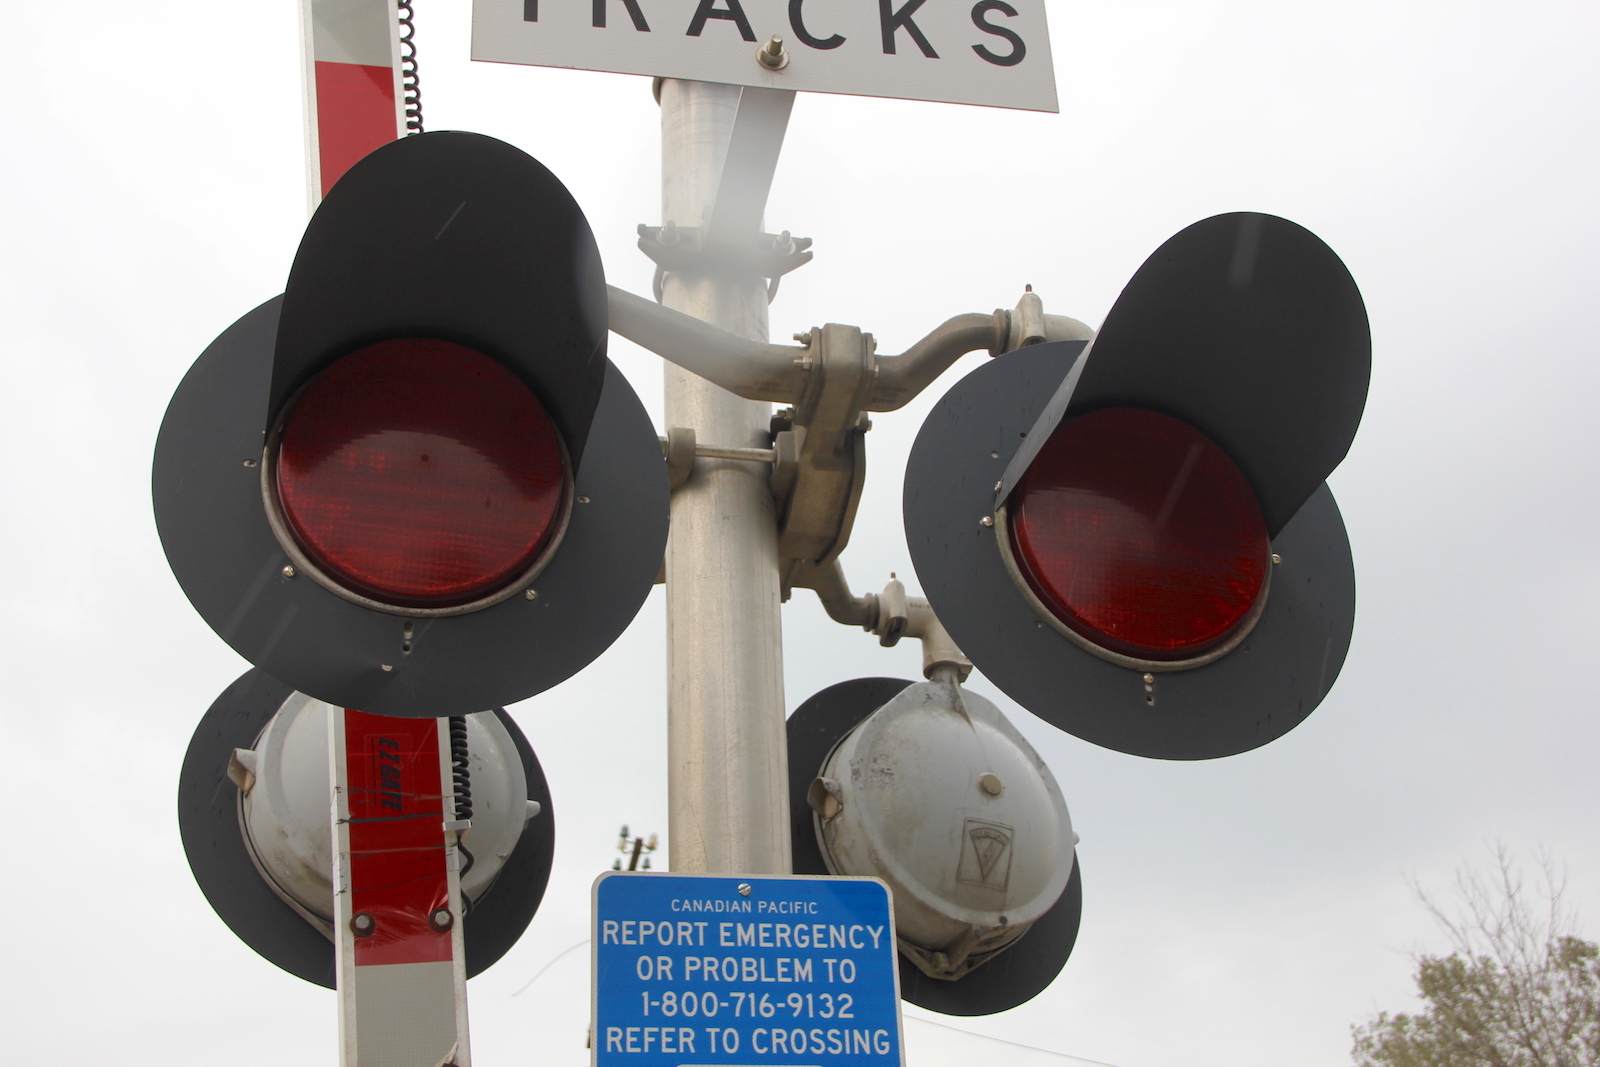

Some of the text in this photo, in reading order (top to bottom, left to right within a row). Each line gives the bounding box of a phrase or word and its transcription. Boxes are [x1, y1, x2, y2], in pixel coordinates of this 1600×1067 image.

[381, 764, 402, 812] GATE
[671, 899, 818, 914] CANADIAN PACIFIC
[603, 920, 884, 950] REPORT EMERGENCY
[636, 955, 856, 983] OR PROBLEM TO
[641, 991, 854, 1019] 1-800-716-9132
[606, 1027, 890, 1055] REFER TO CROSSING
